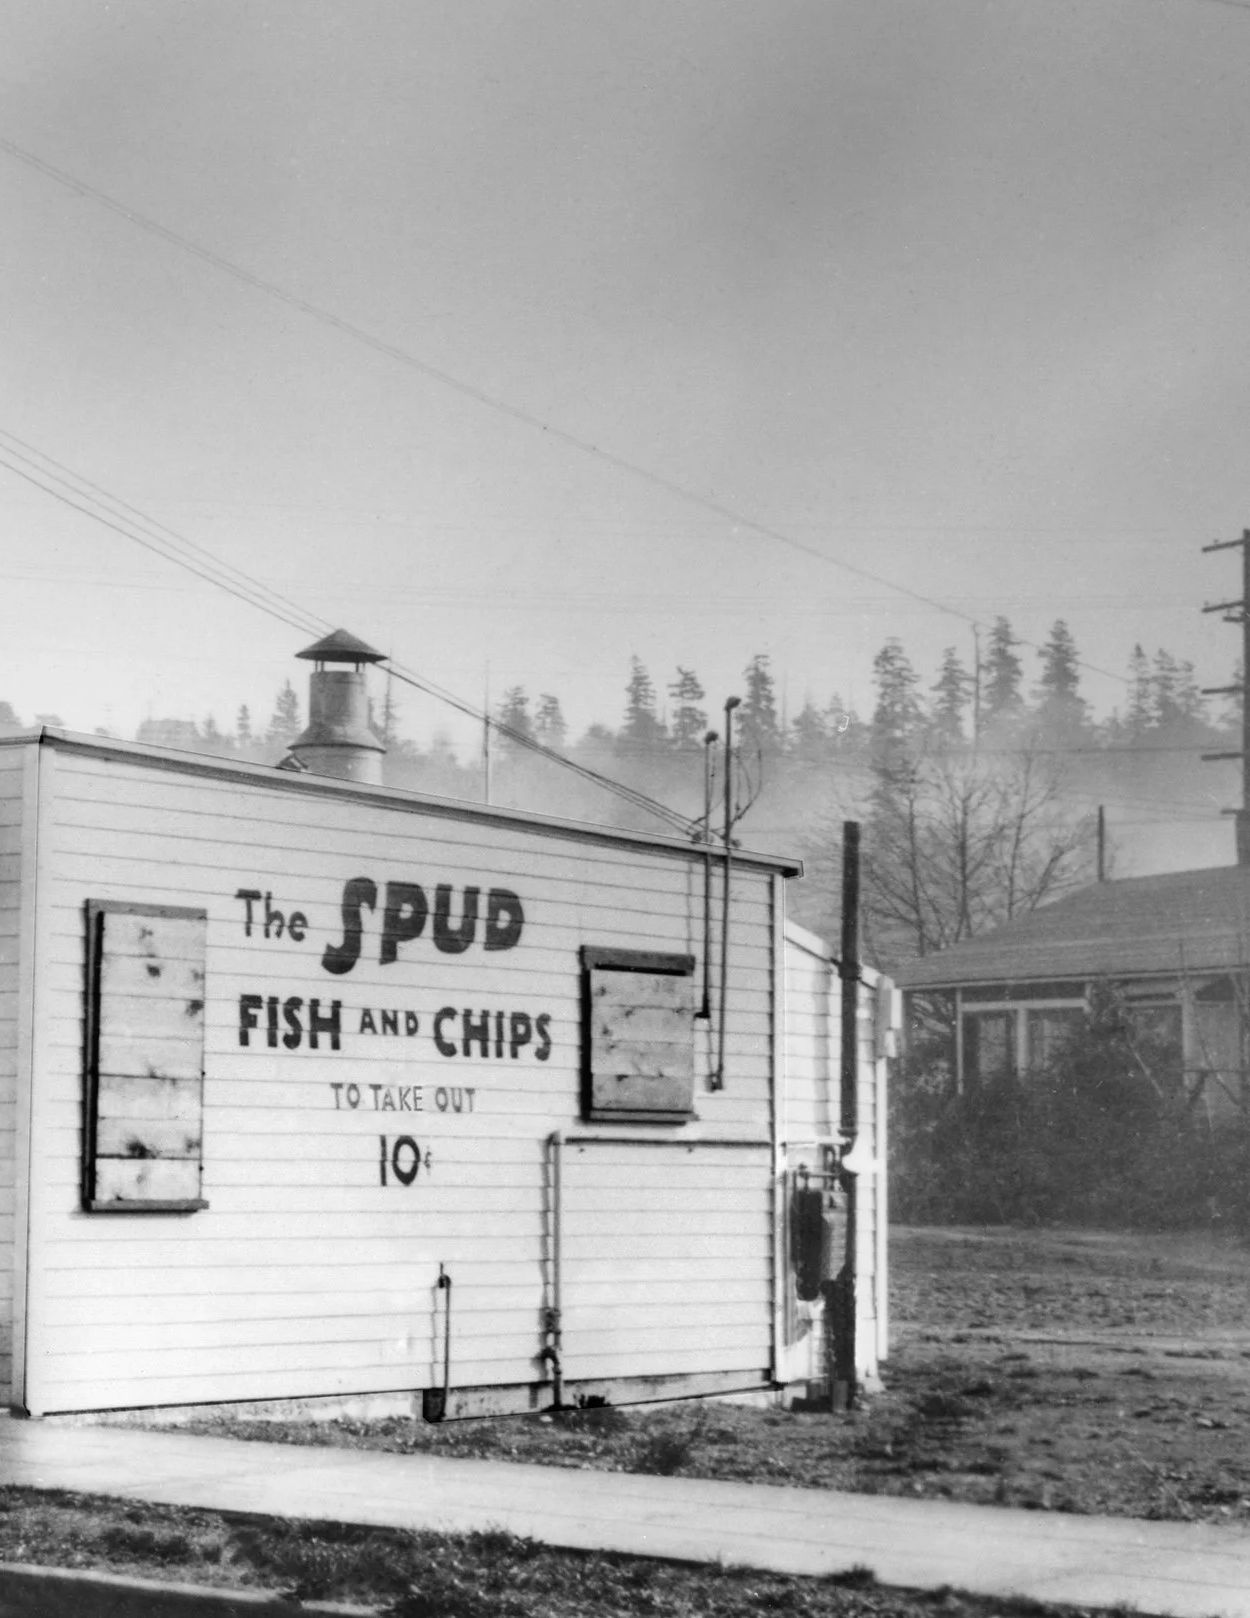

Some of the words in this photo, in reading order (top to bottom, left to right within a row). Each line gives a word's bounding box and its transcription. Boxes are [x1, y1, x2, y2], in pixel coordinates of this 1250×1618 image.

[235, 888, 309, 942] The
[321, 877, 525, 975] SPUD
[239, 994, 342, 1050] FISH
[359, 1007, 419, 1037] AND
[433, 1006, 552, 1061] CHIPS
[330, 1082, 361, 1110] TO
[369, 1083, 423, 1112] TAKE
[434, 1086, 476, 1113] OUT
